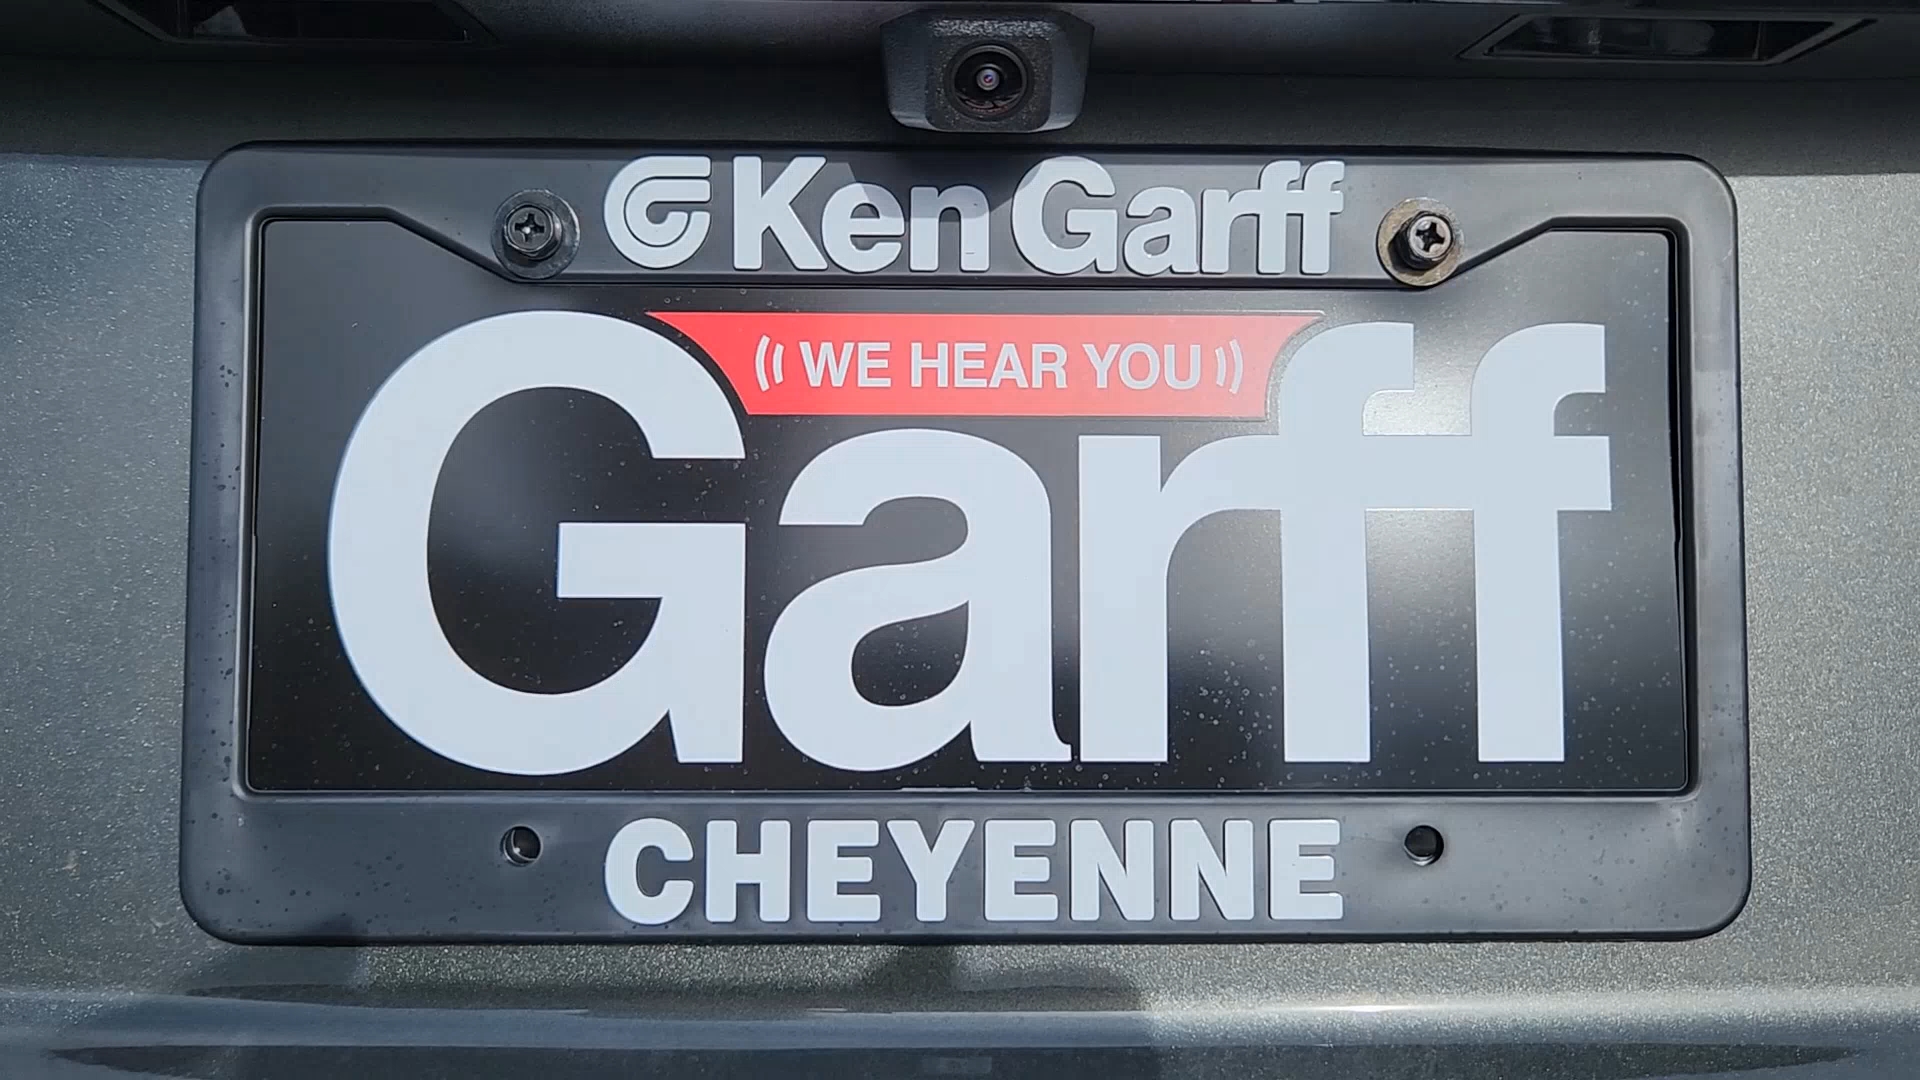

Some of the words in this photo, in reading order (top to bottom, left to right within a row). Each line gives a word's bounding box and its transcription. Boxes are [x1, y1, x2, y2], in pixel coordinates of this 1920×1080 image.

[732, 155, 991, 272] Ken
[1011, 156, 1345, 275] Garff
[799, 341, 891, 389] WE
[910, 341, 1068, 390] HEAR
[1085, 342, 1201, 390] YOU
[327, 310, 1612, 776] Garff
[604, 817, 1345, 925] CHEYENNE
